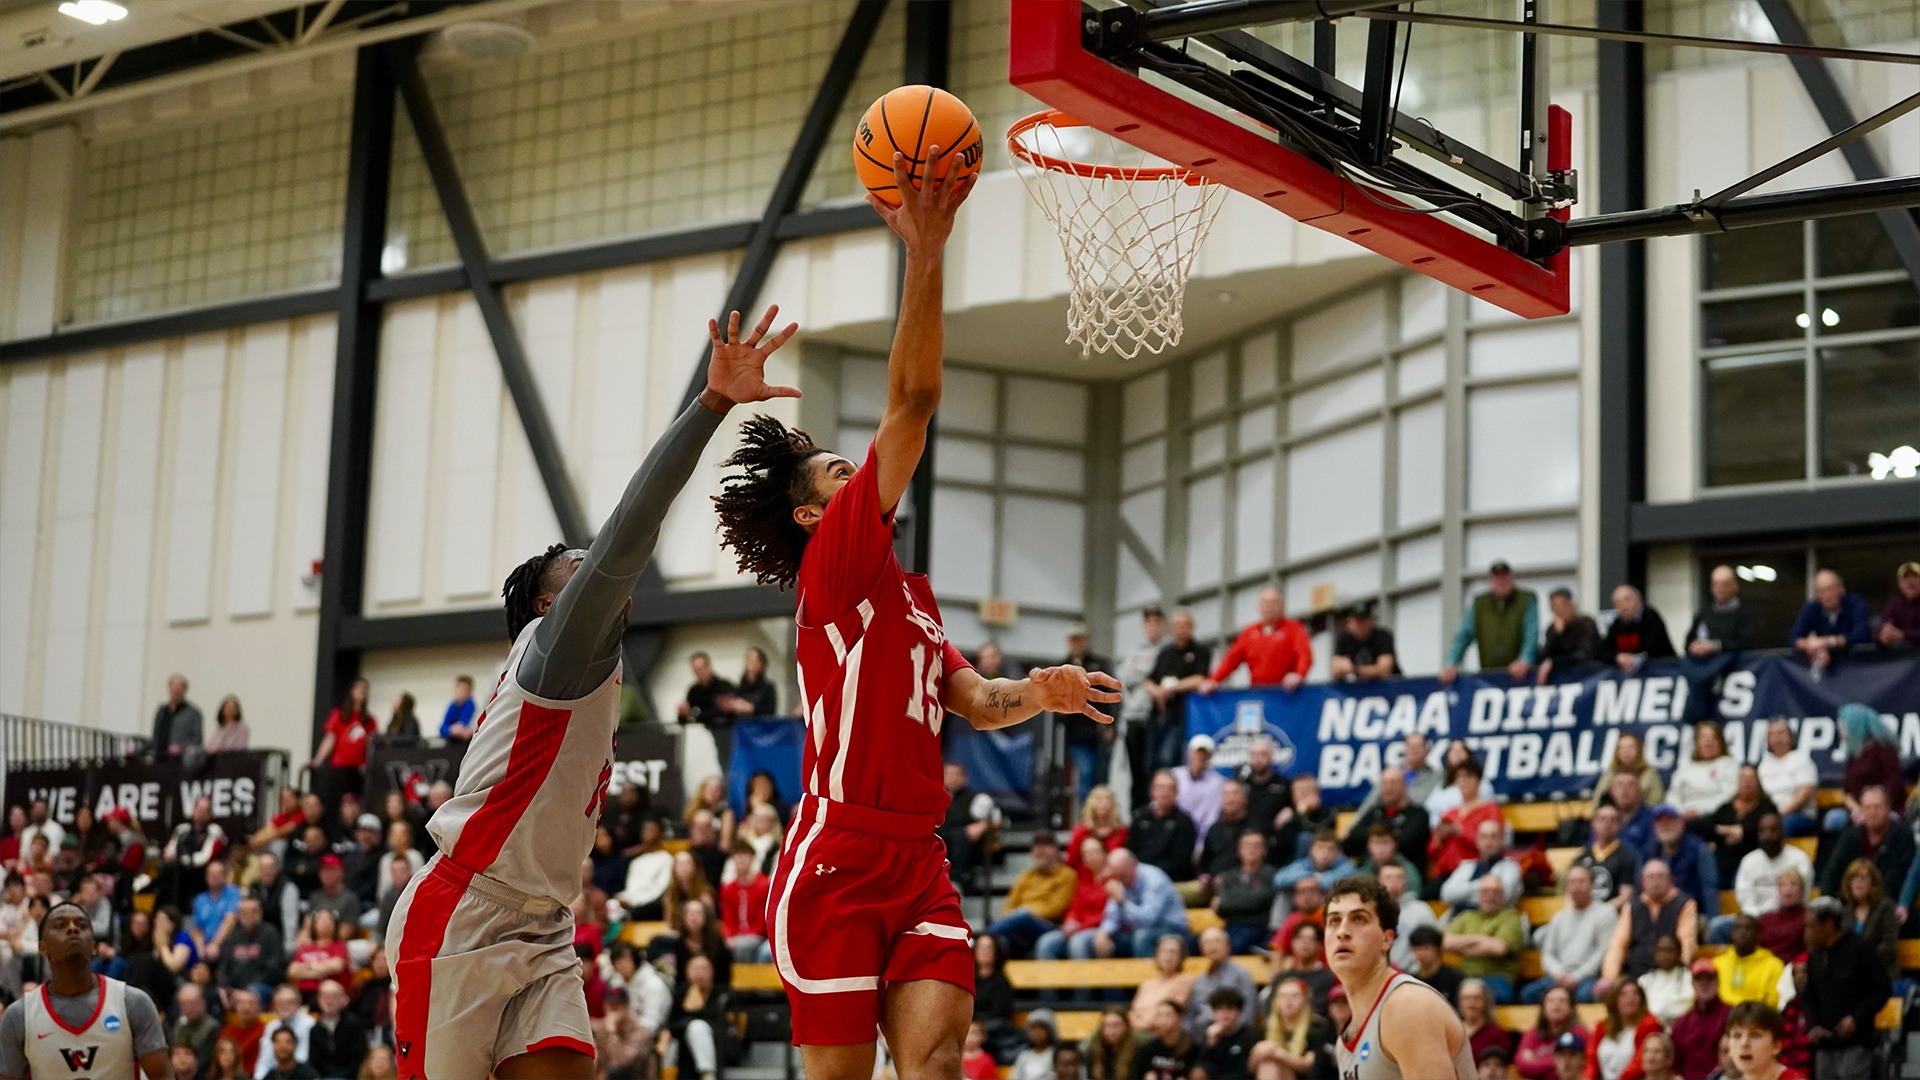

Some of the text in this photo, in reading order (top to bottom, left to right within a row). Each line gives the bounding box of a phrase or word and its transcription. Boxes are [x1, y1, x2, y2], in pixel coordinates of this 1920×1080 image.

[905, 642, 944, 737] 15
[1317, 691, 1450, 742] NCAA
[1468, 682, 1584, 733] DIII
[611, 760, 668, 796] EST
